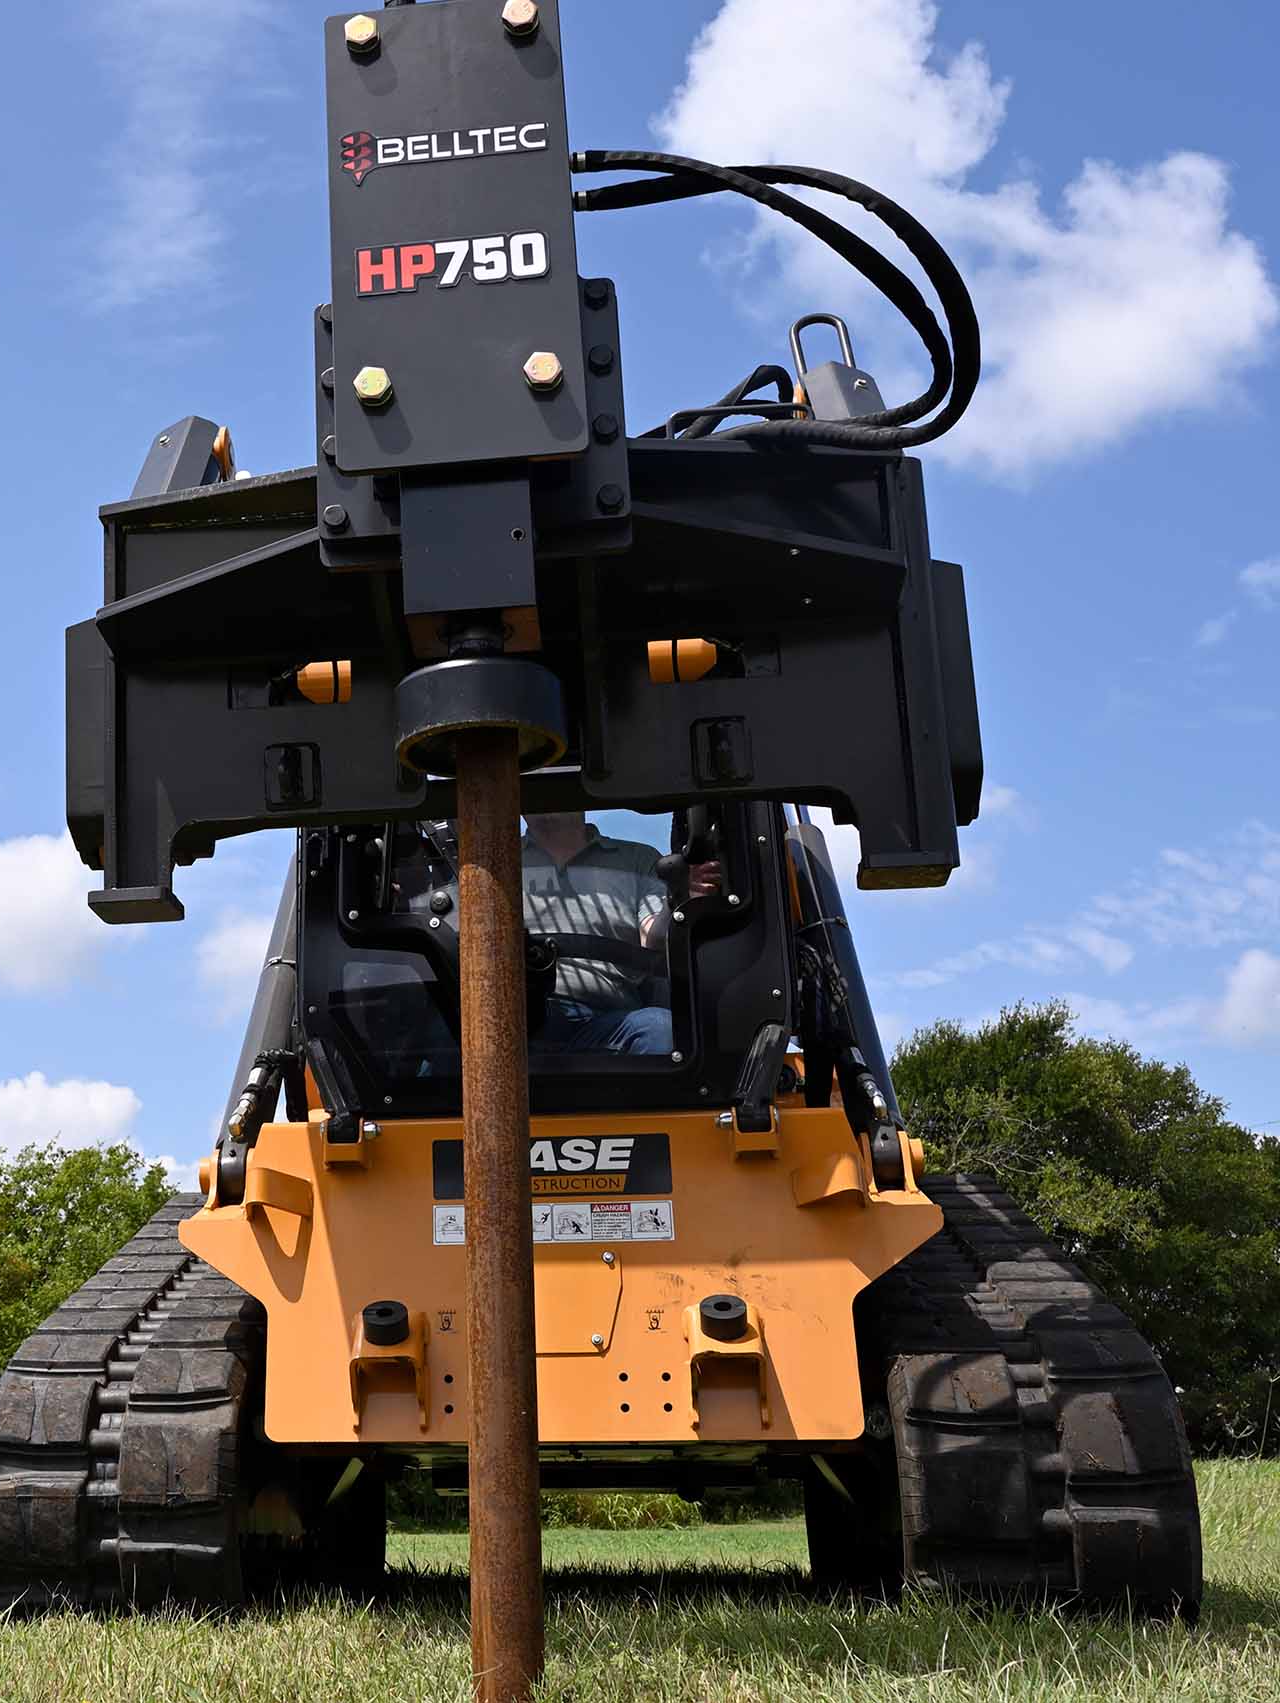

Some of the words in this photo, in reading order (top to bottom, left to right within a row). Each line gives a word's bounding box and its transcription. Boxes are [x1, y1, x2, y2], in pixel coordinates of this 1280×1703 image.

[377, 123, 546, 164] BELLTEC
[357, 232, 547, 292] HP750
[529, 1138, 634, 1171] ASE
[532, 1177, 620, 1191] STRUCTION
[600, 1204, 629, 1212] DANGER
